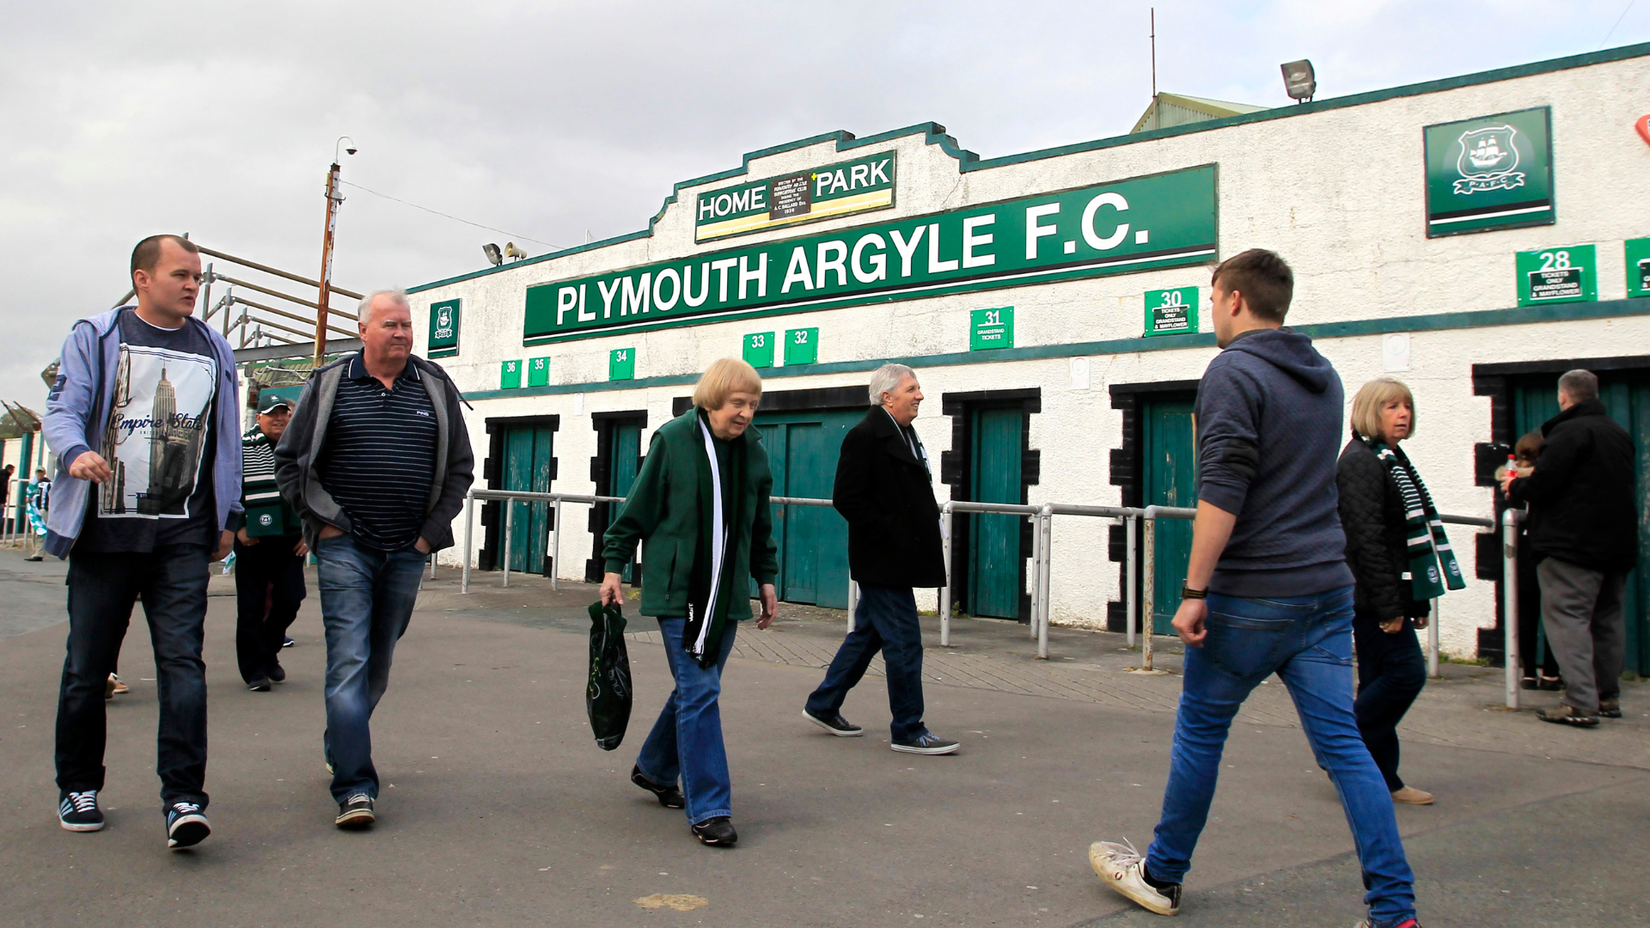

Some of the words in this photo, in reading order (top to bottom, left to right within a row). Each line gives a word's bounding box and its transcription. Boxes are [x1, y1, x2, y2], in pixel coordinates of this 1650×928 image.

[699, 185, 767, 221] HOME
[816, 159, 891, 196] PARK
[557, 253, 768, 325] PLYMOUTH
[781, 214, 996, 293] ARGYLE
[1026, 193, 1149, 259] F.C.
[1539, 250, 1571, 271] 28
[1541, 271, 1569, 279] TICKETS
[1533, 282, 1579, 291] GRANDSTAND
[1539, 288, 1581, 297] MAYFLOWER
[1161, 290, 1182, 306] 30
[985, 310, 1000, 324] 31
[752, 334, 765, 348] 33
[795, 330, 808, 344] 32
[616, 350, 627, 363] 34
[506, 361, 516, 373] 36
[534, 358, 544, 370] 35
[112, 413, 164, 439] Empire
[169, 412, 203, 430] State
